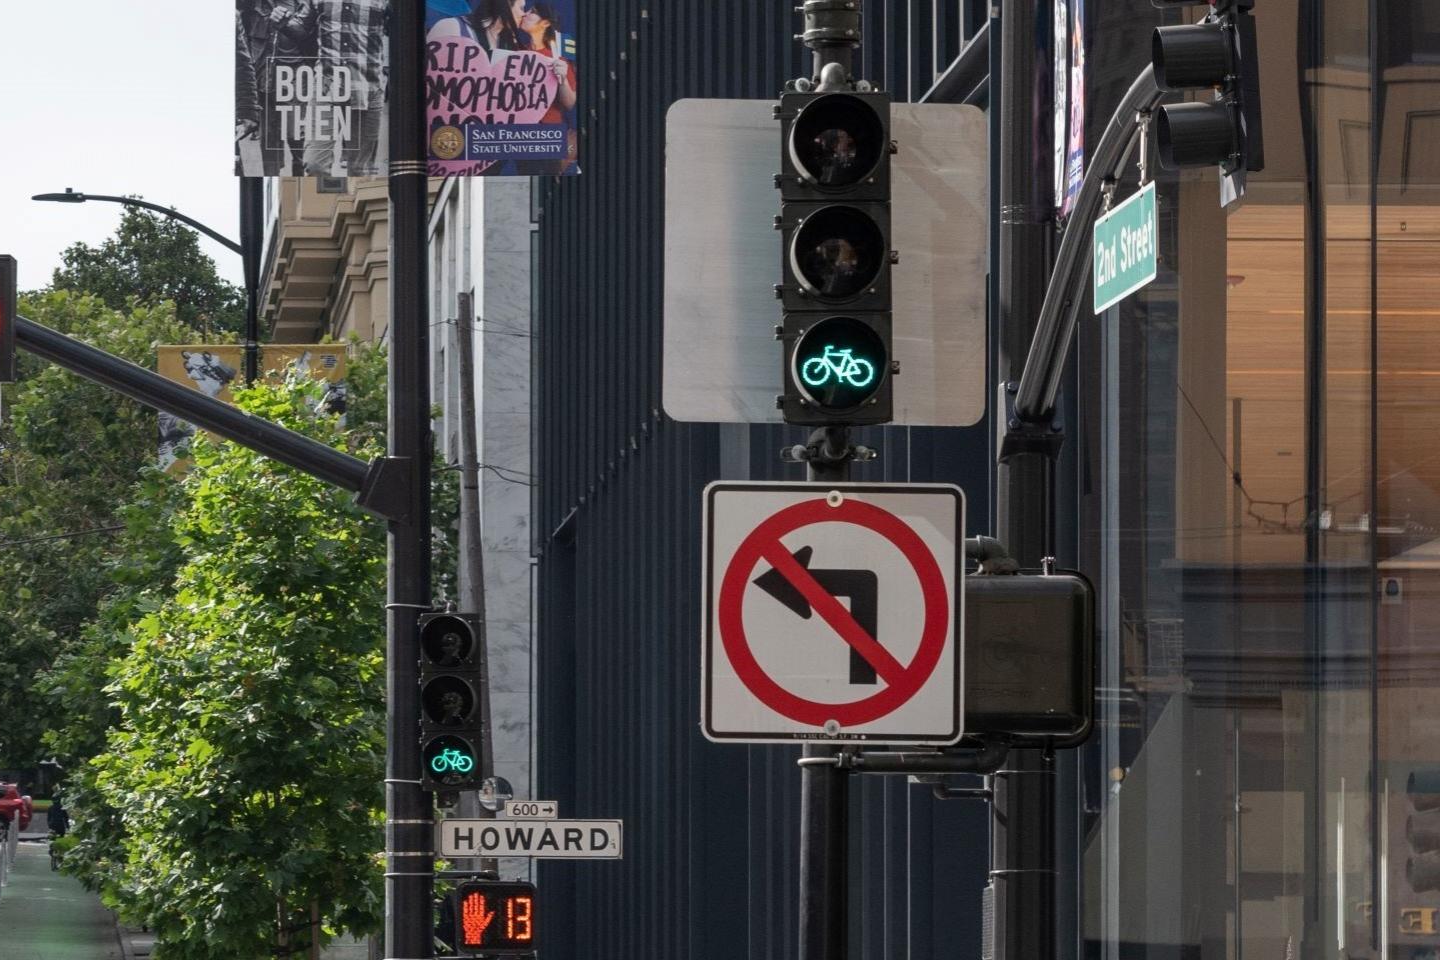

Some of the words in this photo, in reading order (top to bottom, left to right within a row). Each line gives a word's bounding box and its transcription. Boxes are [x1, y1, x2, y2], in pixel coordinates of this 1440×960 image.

[504, 54, 547, 83] END
[275, 65, 351, 102] BOLD
[276, 105, 351, 141] THEN
[472, 129, 495, 140] SAN
[499, 129, 562, 140] FRANCISCO
[472, 144, 500, 153] STATE
[503, 144, 562, 153] UNIVERSITY
[1097, 233, 1116, 287] 2nd
[1120, 209, 1152, 273] Street
[512, 803, 538, 816] 600
[454, 827, 609, 851] HOWARD
[507, 898, 531, 940] 13
